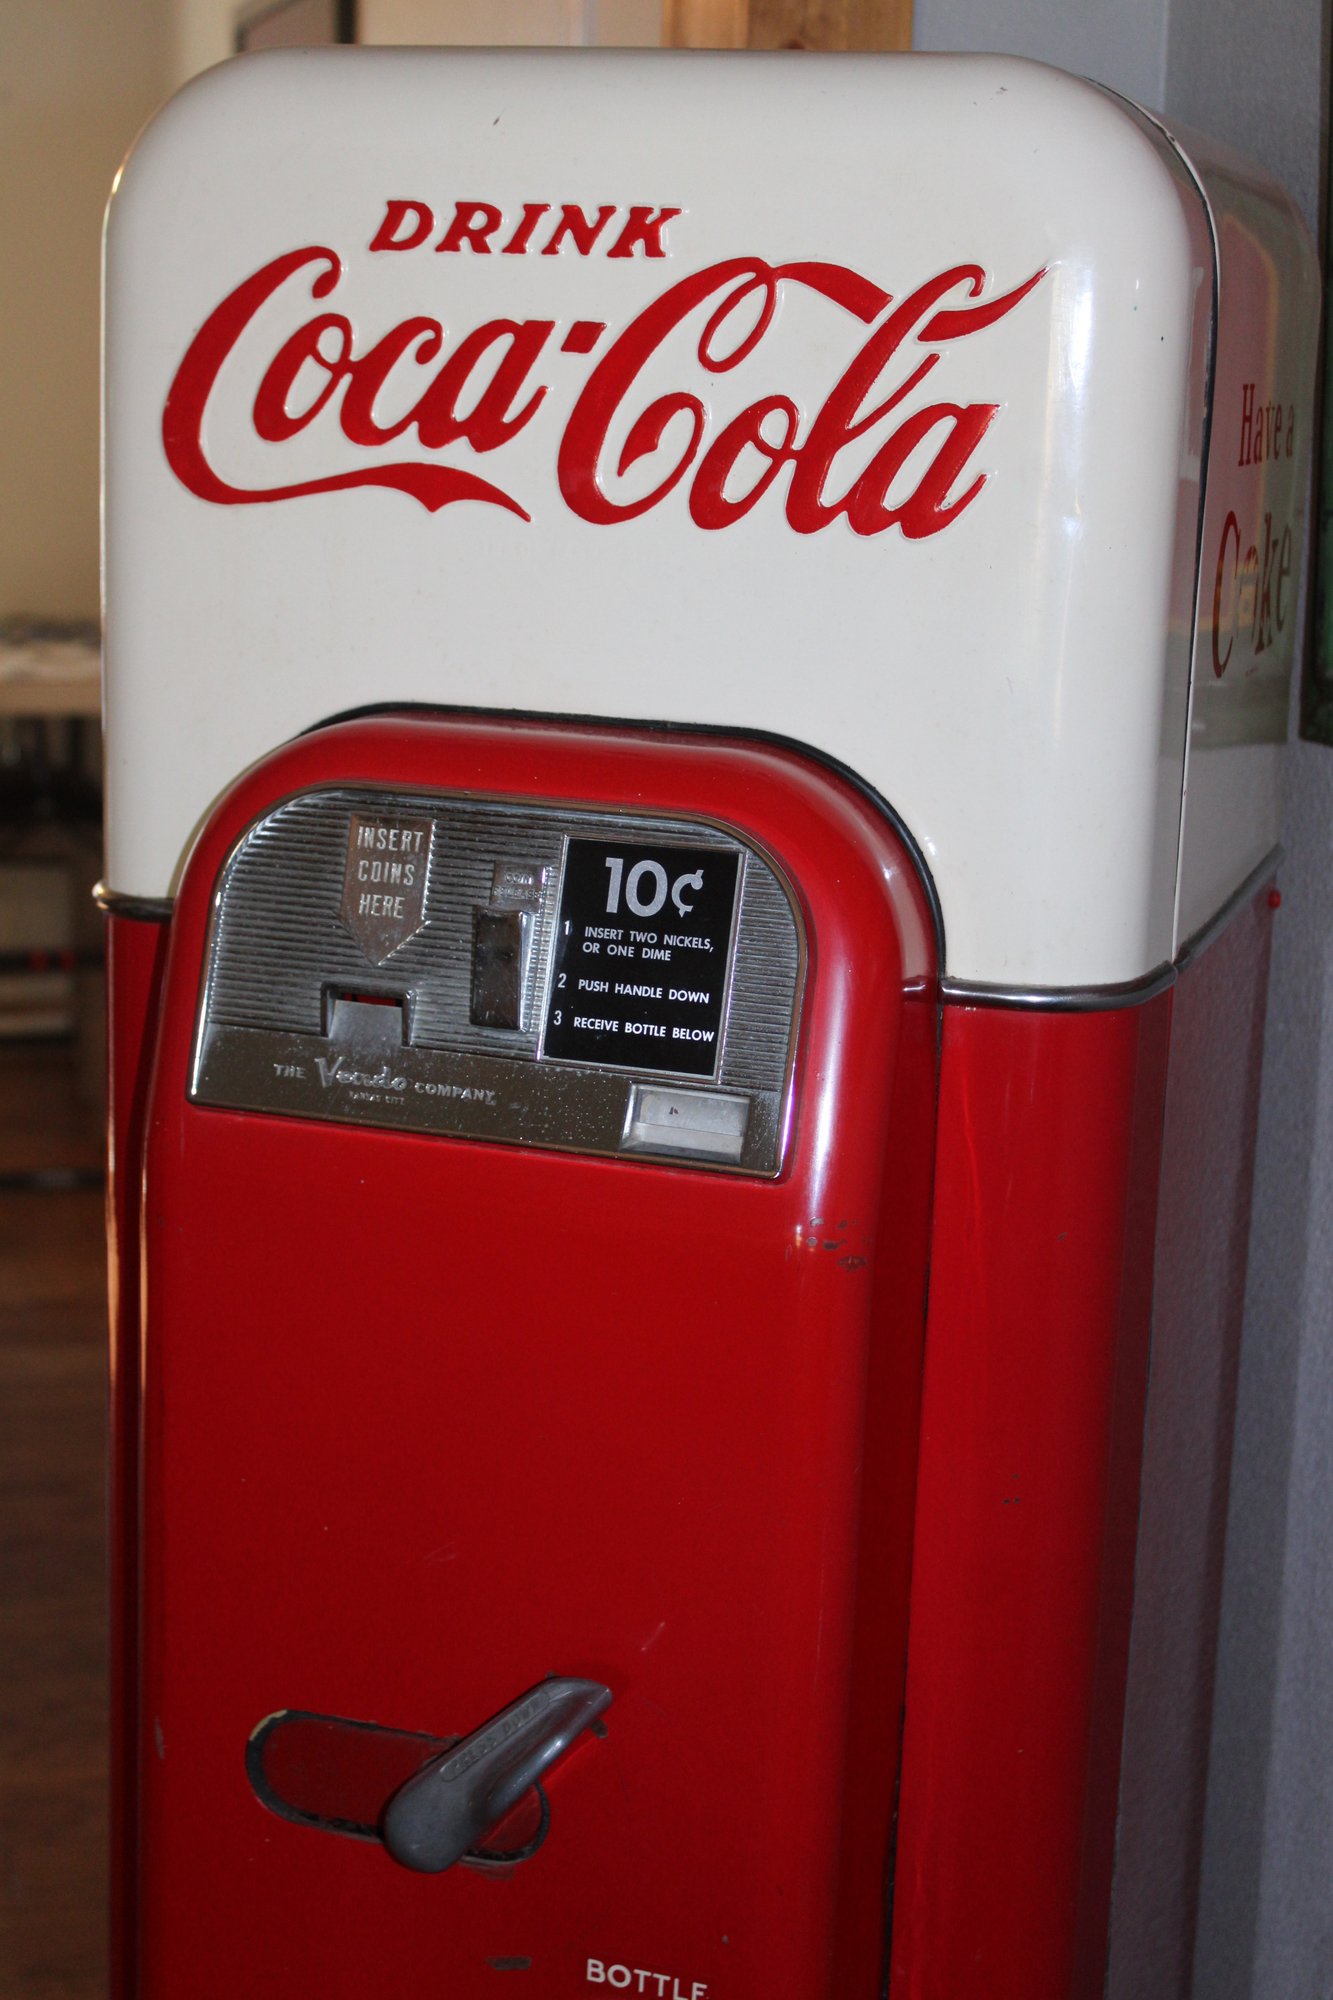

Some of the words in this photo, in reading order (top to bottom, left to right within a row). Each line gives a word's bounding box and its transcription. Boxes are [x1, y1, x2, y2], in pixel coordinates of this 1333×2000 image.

[369, 200, 682, 258] DRINK
[161, 245, 1045, 540] Coca-Cola
[1238, 383, 1282, 467] Have
[1286, 404, 1294, 458] a
[1212, 510, 1291, 679] Coke
[357, 826, 424, 852] INSERT
[358, 860, 415, 886] COINS
[605, 857, 704, 918] 10¢
[358, 893, 405, 918] HERE
[564, 920, 571, 935] 1
[584, 926, 624, 941] INSERT
[629, 931, 658, 944] TWO
[663, 934, 714, 953] NICKELS,
[582, 942, 600, 954] OR
[607, 944, 634, 958] ONE
[642, 948, 672, 961] DIME
[557, 973, 567, 988] 2
[578, 979, 609, 993] PUSH
[614, 983, 663, 999] HANDLE
[668, 989, 710, 1004] DOWN
[553, 1010, 563, 1026] 3
[573, 1016, 619, 1032] RECEIVE
[624, 1022, 667, 1037] BOTTLE
[672, 1027, 715, 1042] BELOW
[273, 1063, 306, 1079] THE
[314, 1056, 407, 1092] Vendo
[586, 1958, 708, 2000] BOTTLE
